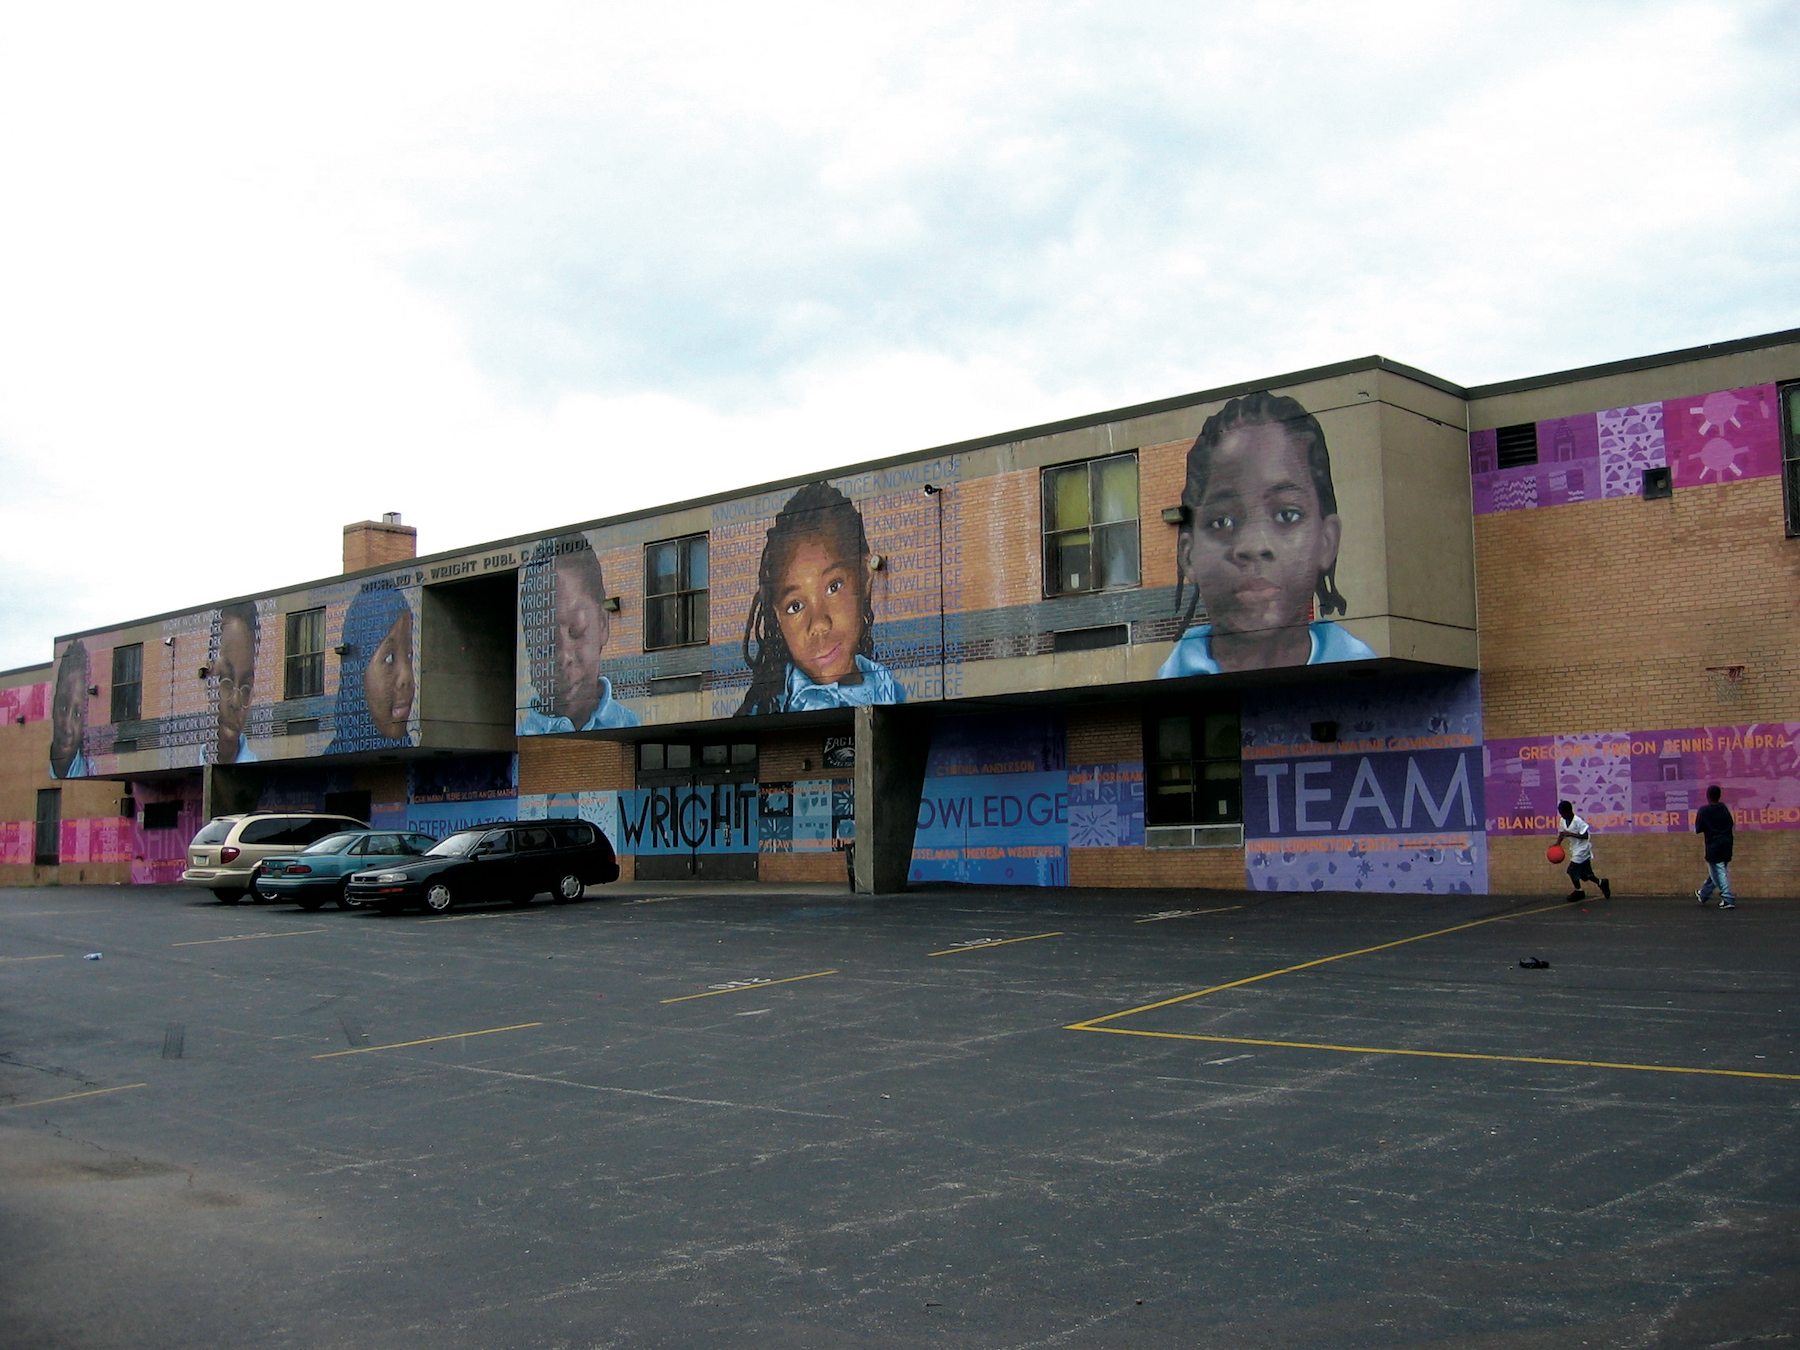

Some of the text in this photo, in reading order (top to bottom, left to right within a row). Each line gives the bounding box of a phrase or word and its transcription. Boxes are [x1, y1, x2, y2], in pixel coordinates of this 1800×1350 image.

[712, 493, 786, 522] KNOWLEDGE
[874, 458, 962, 493] KNOWLEDGE
[874, 502, 962, 533] KNOWLEDGE
[874, 524, 962, 553] KNOWLEDGE
[430, 561, 477, 580] WRIGHT
[873, 570, 963, 596] KNOWLEDGE
[255, 599, 278, 612] WORK
[520, 591, 557, 610] WRIGHT
[873, 590, 963, 616] KNOWLEDGE
[162, 609, 223, 631] WORK WORK WORK
[873, 634, 963, 660] KNOWLEDGE
[160, 715, 219, 734] WORK WORK WORK
[252, 709, 274, 721] WORK
[160, 728, 219, 747] WORK WORK WORK
[251, 722, 274, 735] WORK
[1387, 734, 1474, 751] COVINGTON
[1519, 743, 1595, 761] GREGORY
[1664, 737, 1713, 753] DENNIS
[1717, 733, 1787, 750] FIANDRA
[982, 760, 1035, 774] ANDERSON
[1254, 752, 1477, 833] TEAM
[617, 790, 757, 849] WRIGHT
[916, 792, 1067, 830] OWLEDGE
[409, 816, 517, 839] DETERMIN
